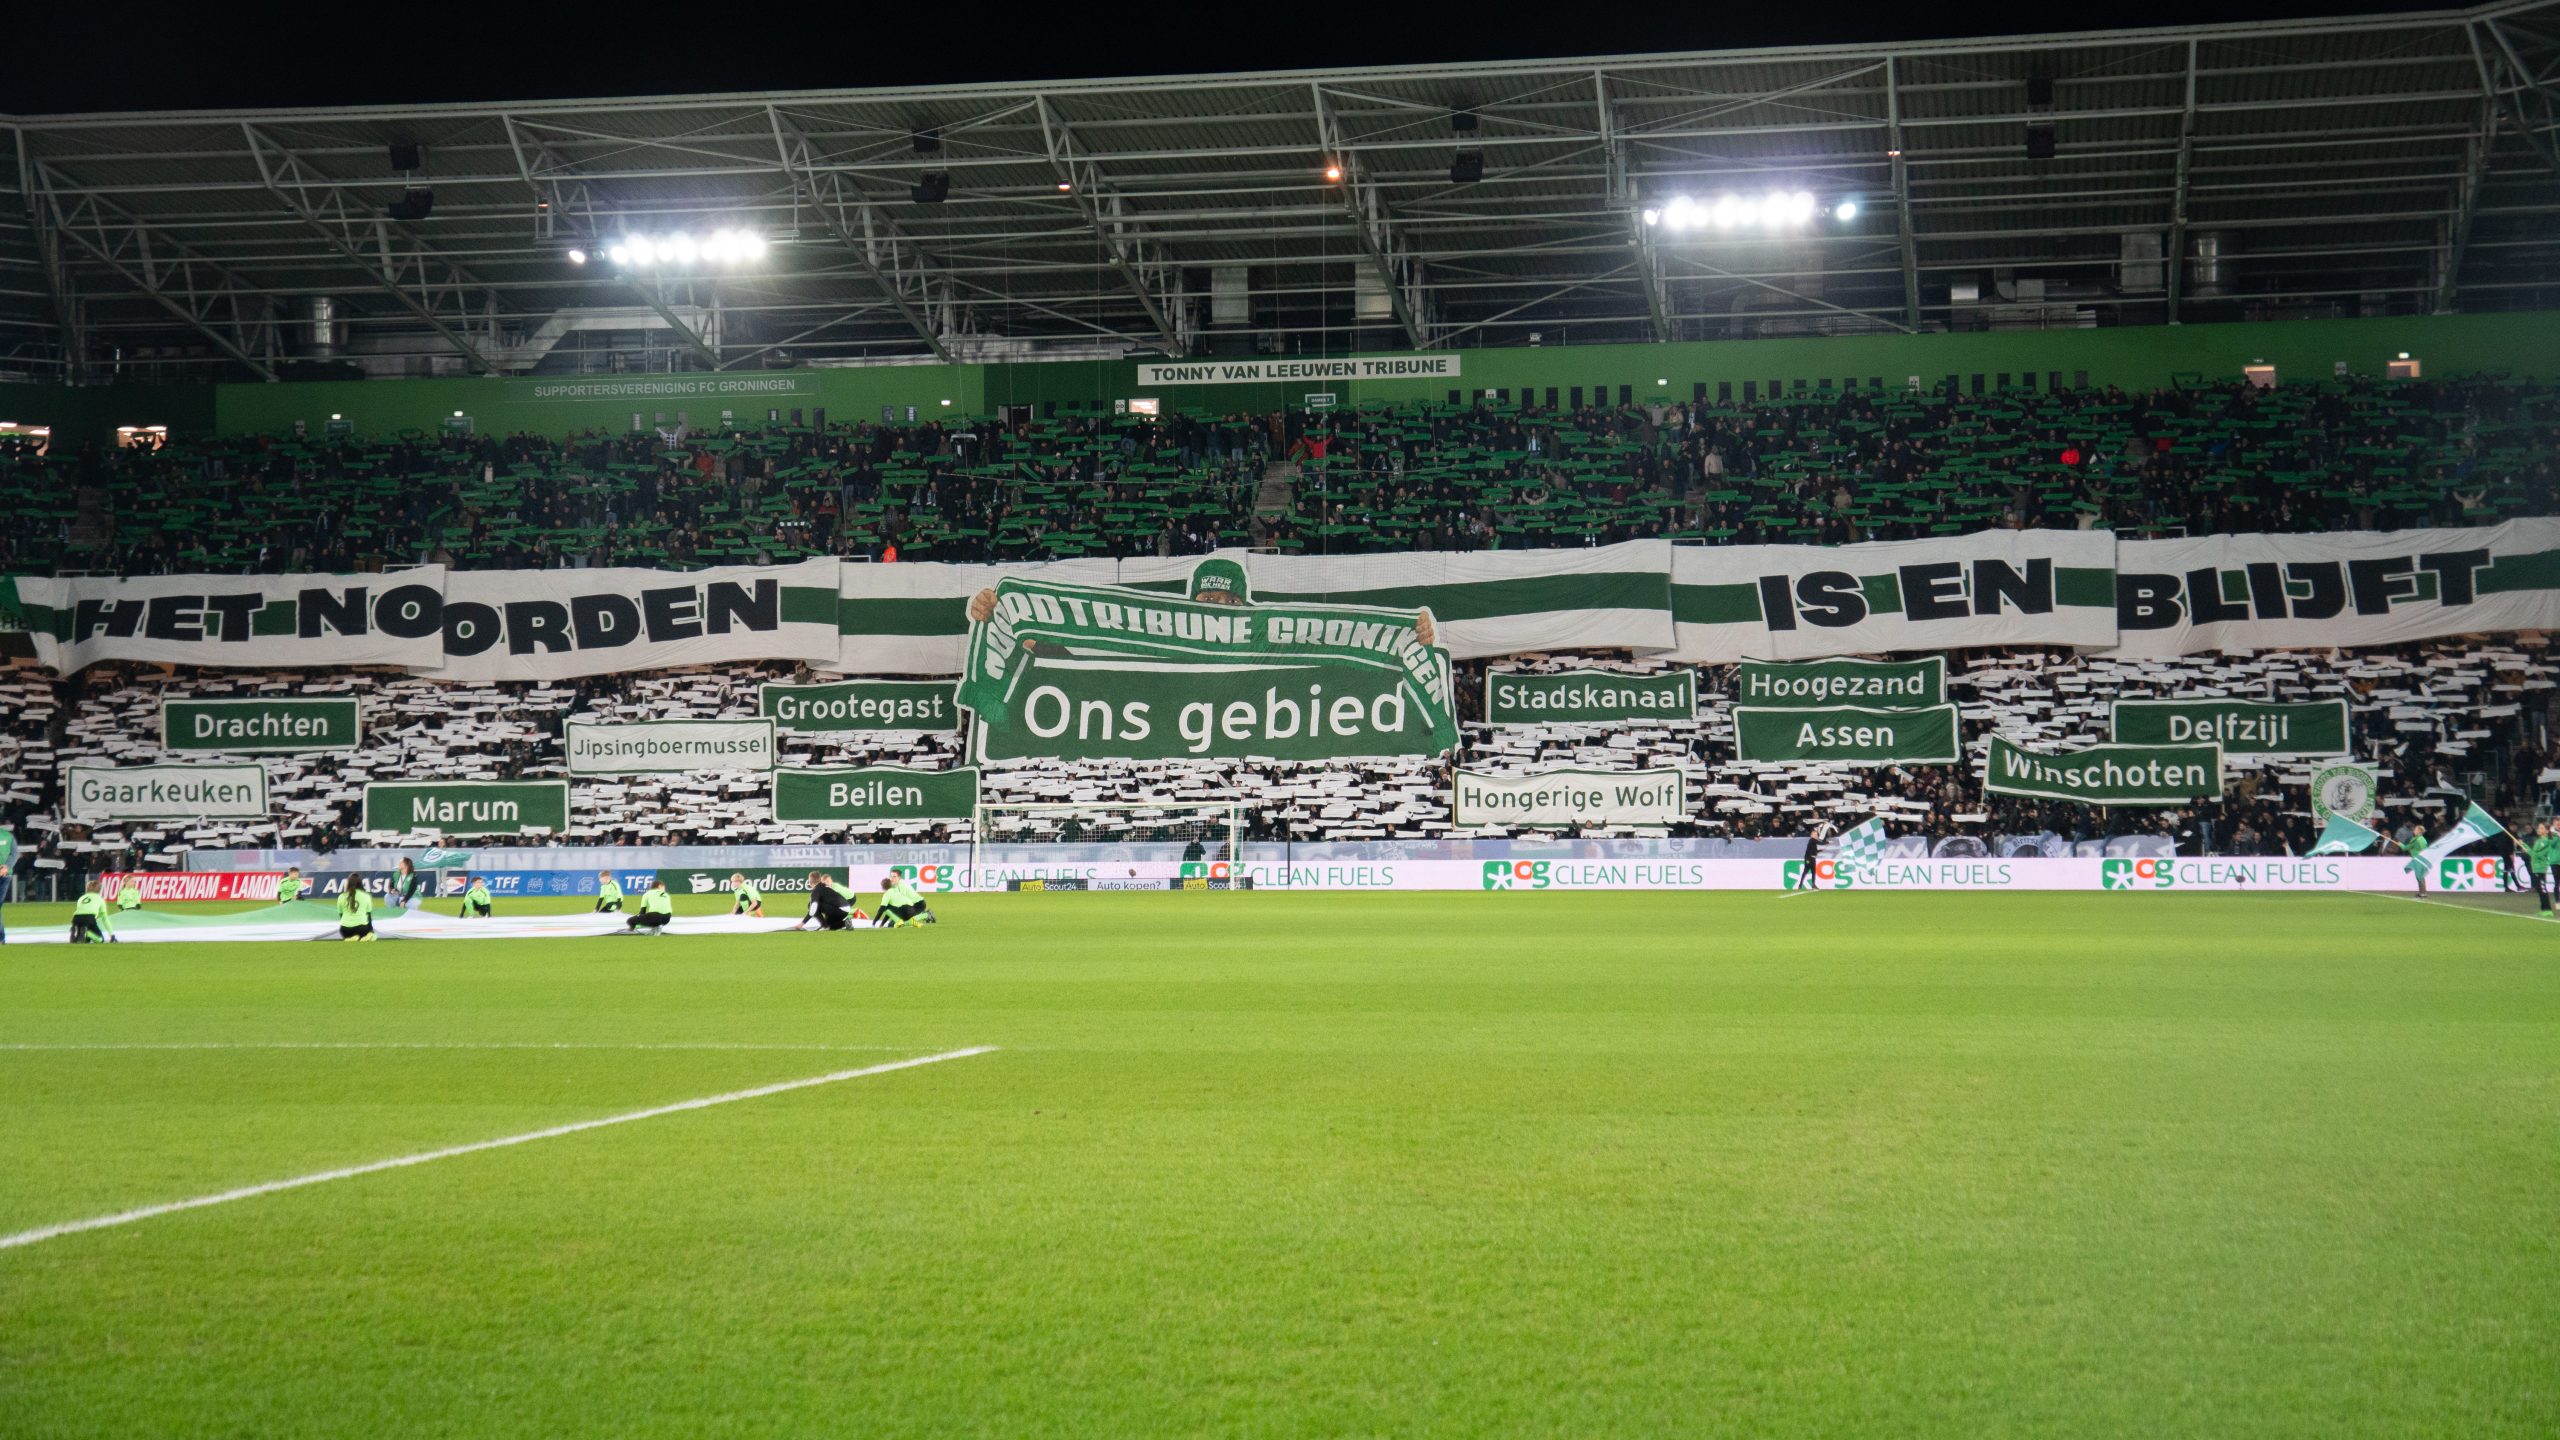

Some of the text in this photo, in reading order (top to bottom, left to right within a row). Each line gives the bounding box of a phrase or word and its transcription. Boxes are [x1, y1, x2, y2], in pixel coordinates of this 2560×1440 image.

[1152, 360, 1447, 381] TONNY VAN LEEUWEN TRIBUNE
[534, 379, 795, 397] SUPPORTERSVERENIGING FC GRONINGEN
[1759, 548, 2490, 632] IS EN BLIJFT
[75, 579, 777, 656] HET NOORDEN
[985, 592, 1443, 705] NOORDTRIBUNE GRONINGEN
[1498, 682, 1685, 709] Stadskanaal
[1750, 670, 1924, 701] Hoogezand
[777, 693, 943, 724] Grootegast
[1024, 681, 1405, 753] Ons gebied
[194, 711, 328, 738] Drachten
[1796, 722, 1894, 748] Assen
[2169, 712, 2289, 748] Delfzijl
[574, 736, 767, 759] Jipsingboermussel
[2004, 749, 2206, 788] Winschoten
[81, 778, 251, 803] Gaarkeuken
[829, 780, 923, 807] Beilen
[1464, 784, 1675, 812] Hongerige Wolf
[412, 796, 519, 822] Marum
[495, 876, 520, 889] TFF
[625, 875, 654, 889] TFF
[719, 873, 813, 891] nrdlease
[1097, 881, 1161, 891] Auto kopen?
[1251, 866, 1319, 886] CLEAN
[1328, 866, 1394, 886] FUELS
[1556, 865, 1627, 885] CLEAN
[1635, 865, 1703, 885] FUELS
[1941, 864, 2012, 884] FUELS
[2180, 863, 2257, 883] CLEAN
[2267, 863, 2340, 883] FUELS
